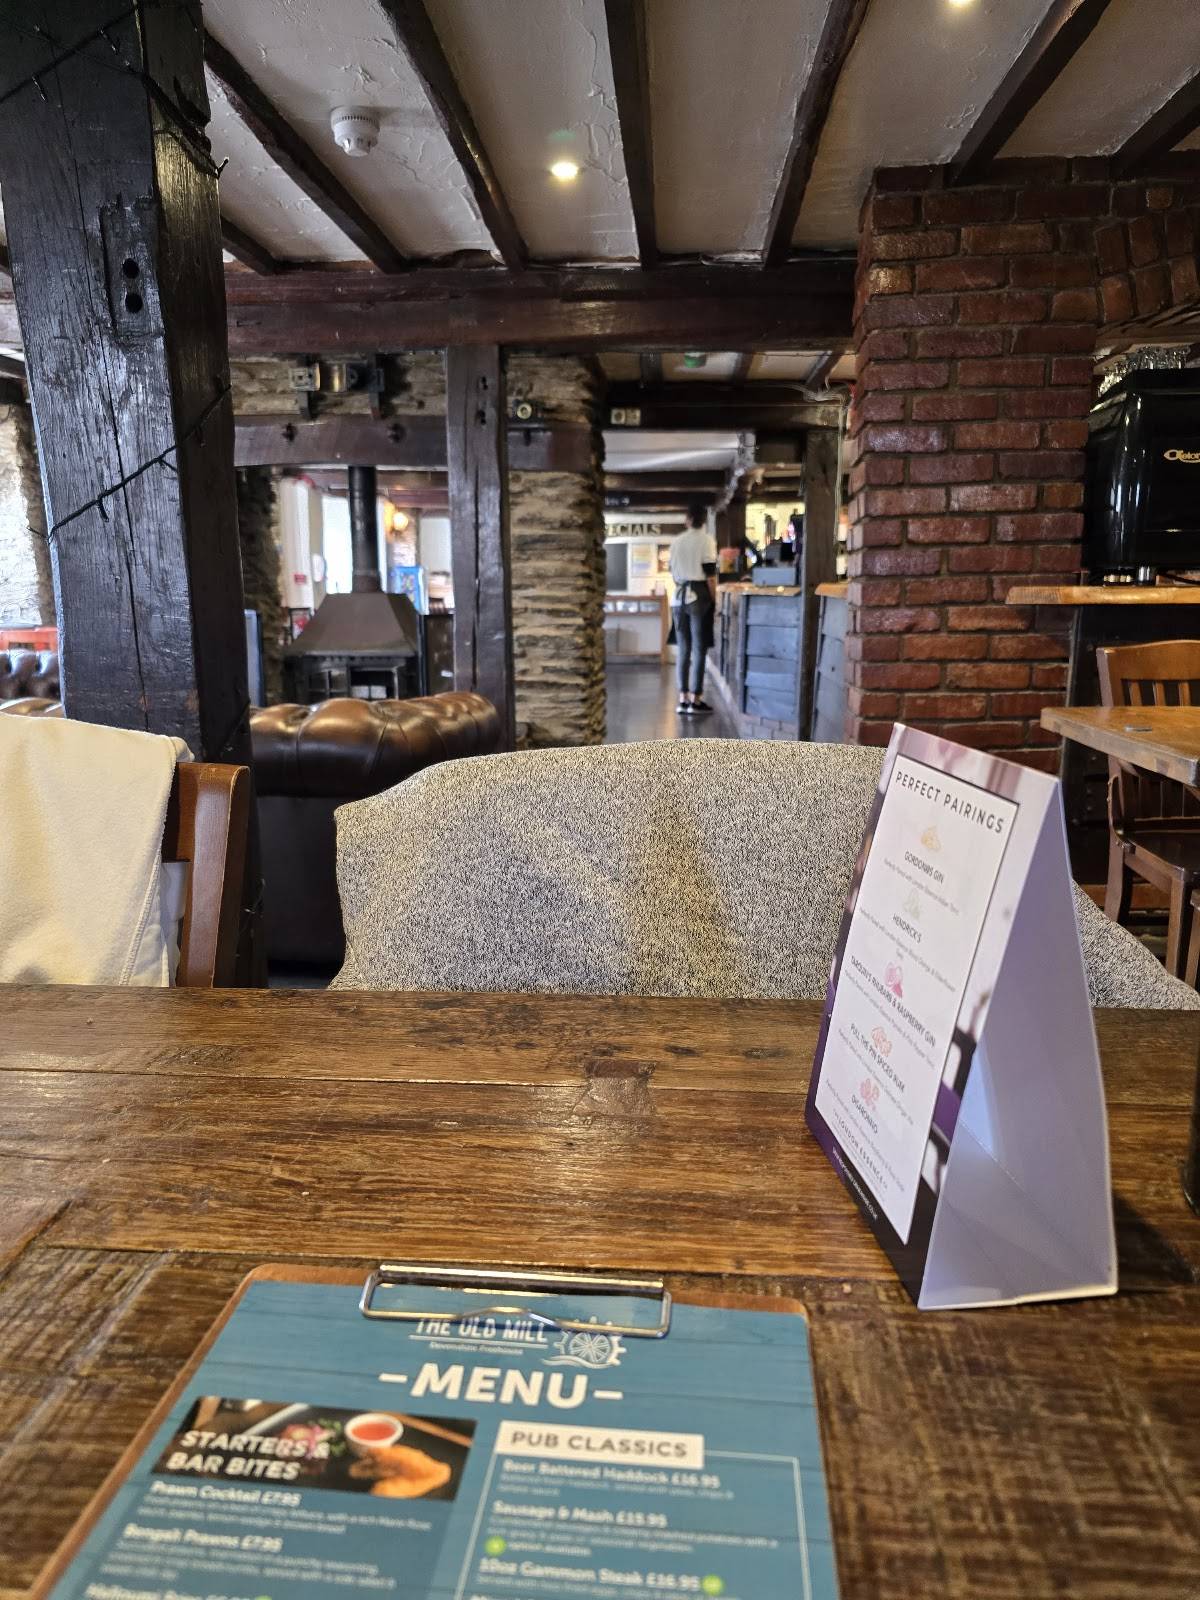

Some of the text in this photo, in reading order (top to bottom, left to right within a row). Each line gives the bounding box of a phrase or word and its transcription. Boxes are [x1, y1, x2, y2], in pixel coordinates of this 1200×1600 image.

[896, 771, 1004, 834] PERFECT PAIRINGS
[924, 1031, 936, 1048] GIN
[502, 1319, 548, 1343] MILL
[410, 1362, 588, 1409] MENU
[179, 1430, 330, 1459] STARTERS &
[511, 1430, 688, 1458] PUB CLASSICS
[166, 1451, 301, 1480] BAR BITES
[538, 1462, 602, 1480] Battered
[603, 1466, 669, 1485] Haddock
[200, 1485, 262, 1503] Cocktail
[493, 1500, 555, 1521] Sausage
[572, 1507, 614, 1523] Mash
[520, 1561, 596, 1581] Gammon
[599, 1568, 643, 1586] Steak
